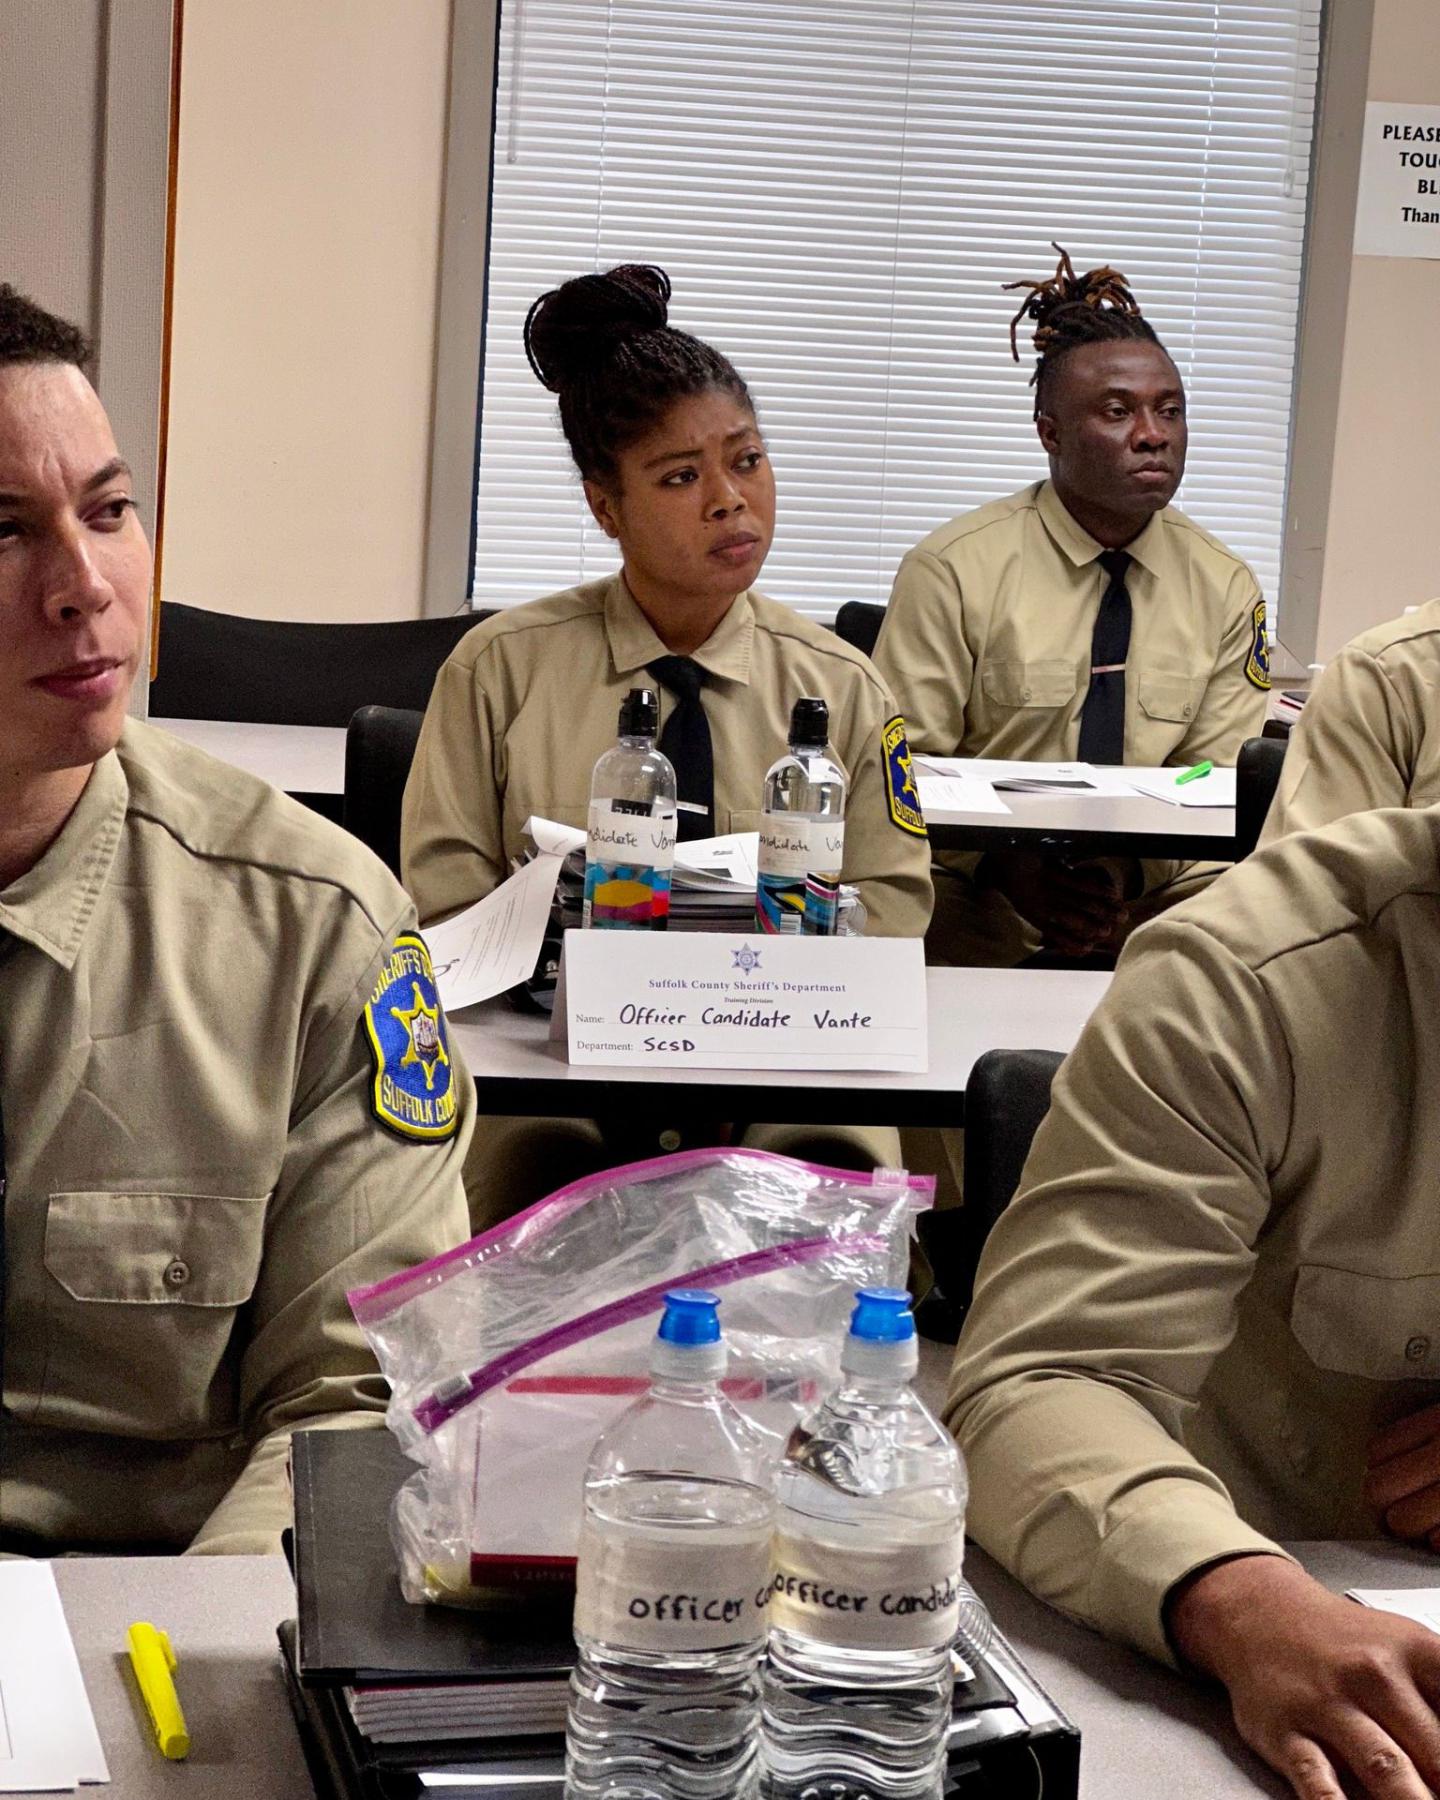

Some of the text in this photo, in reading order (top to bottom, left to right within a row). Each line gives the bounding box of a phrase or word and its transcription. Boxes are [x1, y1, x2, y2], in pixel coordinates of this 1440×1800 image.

[1399, 152, 1440, 168] TOU
[1418, 179, 1440, 194] BL
[648, 979, 846, 994] Suffolk County Sheriff's Department
[576, 1003, 872, 1030] Name: Officer Candidate Vante
[576, 1040, 634, 1051] Department:
[383, 1074, 434, 1125] SUFFOLK
